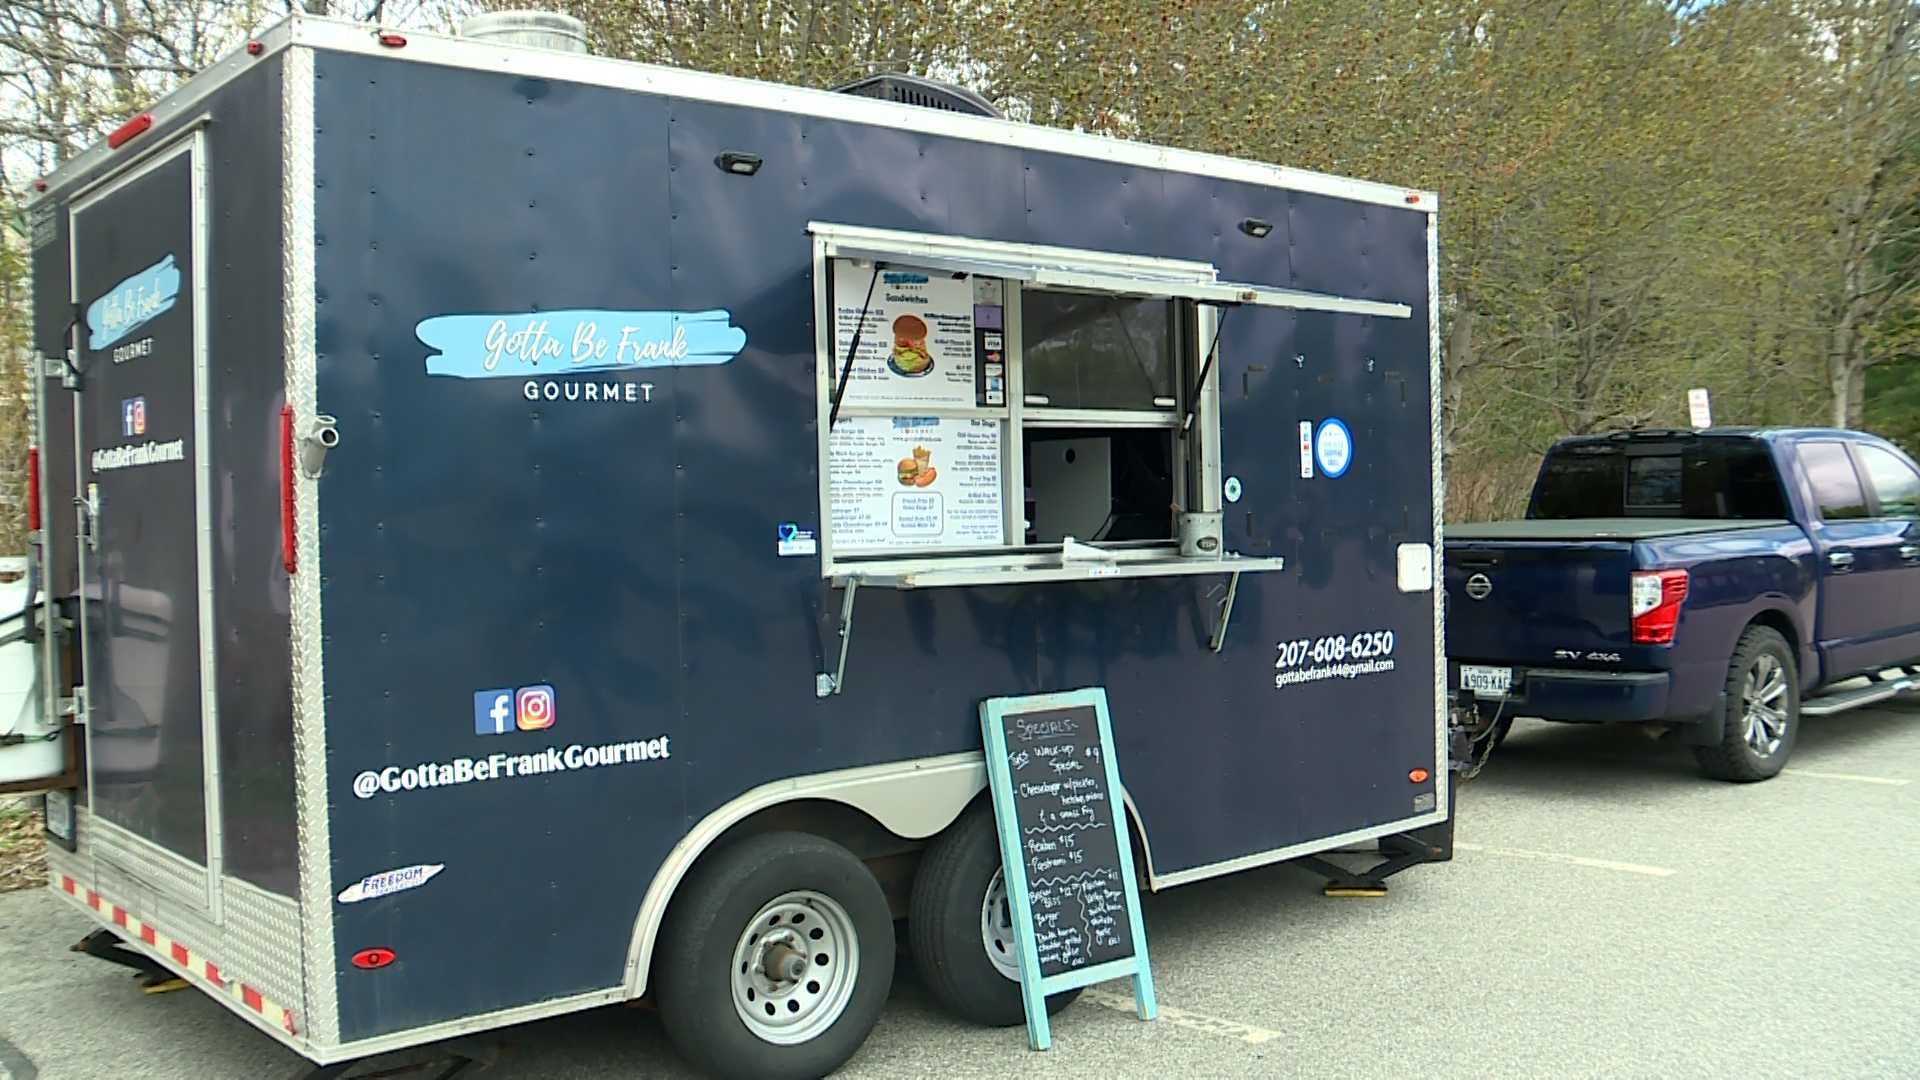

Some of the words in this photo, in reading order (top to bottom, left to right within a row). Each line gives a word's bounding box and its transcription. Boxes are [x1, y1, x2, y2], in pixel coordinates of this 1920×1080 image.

[885, 293, 928, 304] Sandwiches
[483, 319, 563, 372] Gotta
[570, 320, 608, 363] Be
[615, 325, 689, 364] Frank
[523, 380, 655, 402] GOURMET
[1275, 630, 1394, 668] 207-608-6250
[1554, 650, 1583, 661] SV
[1275, 659, 1394, 688] gottabefrank44@gmail.com
[353, 735, 671, 799] @GottaBeFrankGourmet
[362, 867, 423, 893] FREEDOM
